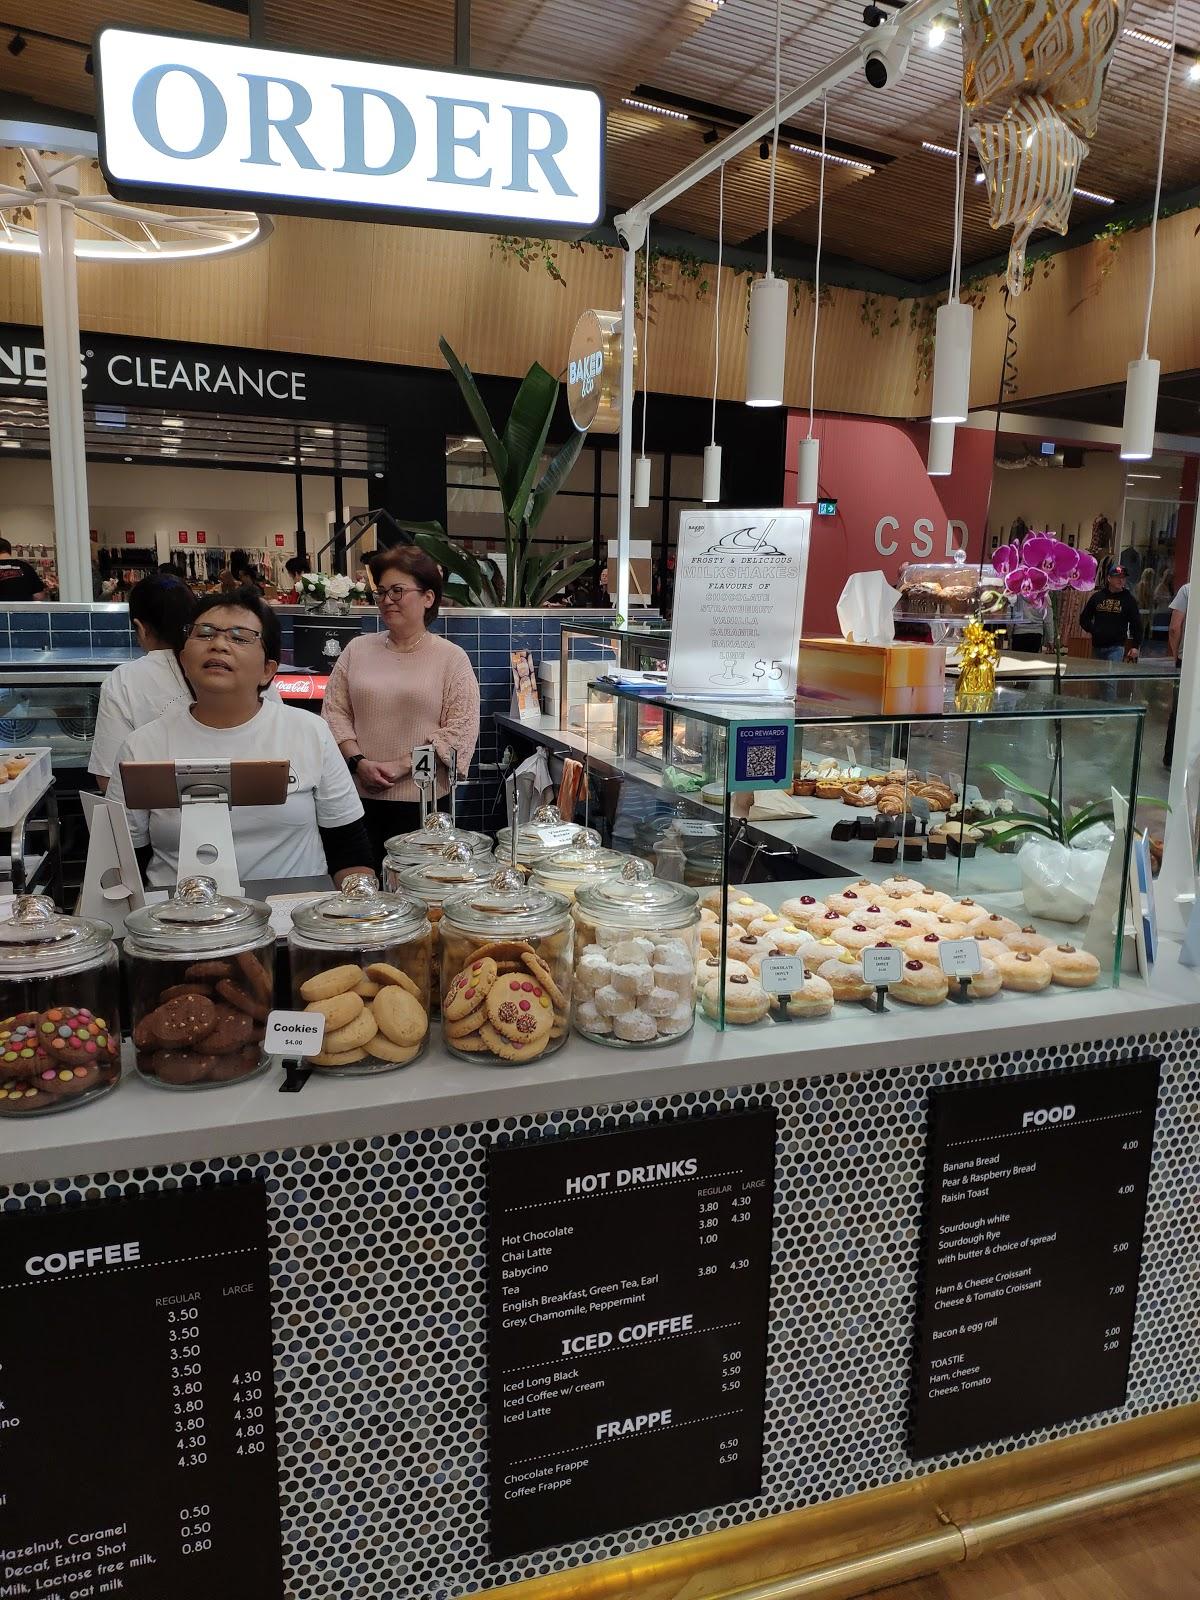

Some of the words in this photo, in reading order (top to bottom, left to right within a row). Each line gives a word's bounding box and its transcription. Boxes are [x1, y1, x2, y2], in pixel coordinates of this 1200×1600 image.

[131, 62, 579, 198] ORDER
[107, 354, 307, 401] CLEARANCE
[569, 351, 603, 385] BAKED
[682, 565, 799, 579] MILKSHAKES
[705, 593, 770, 602] CHOCOLATE
[700, 605, 774, 614] STRAWBERRY
[712, 616, 759, 625] VANILLA
[709, 629, 760, 637] CARAMEL
[711, 640, 756, 649] BANANA
[719, 651, 747, 660] LIME
[752, 658, 784, 682] $5
[740, 730, 754, 738] ECO
[754, 729, 785, 737] REWARDS
[415, 754, 431, 777] 4
[273, 1023, 318, 1033] Cookies
[1022, 1104, 1076, 1128] FOOD
[1122, 1139, 1139, 1151] 4.00
[943, 1160, 975, 1173] Banana
[975, 1153, 1000, 1167] Bread
[566, 1171, 611, 1196] HOT
[616, 1158, 698, 1187] DRINKS
[942, 1178, 961, 1188] Pear
[961, 1175, 969, 1185] &
[969, 1169, 1012, 1183] Raspberry
[1012, 1162, 1037, 1176] Bread
[697, 1184, 733, 1197] REGULAR
[741, 1178, 766, 1191] LARGE
[941, 1191, 966, 1204] Raisin
[966, 1187, 989, 1199] Toast
[1118, 1184, 1135, 1195] 4.00
[699, 1201, 719, 1214] 3.80
[731, 1195, 752, 1207] 4.30
[698, 1217, 719, 1230] 3.80
[730, 1211, 751, 1223] 4.30
[939, 1217, 986, 1235] Sourdough
[986, 1214, 1011, 1225] white
[501, 1234, 521, 1246] Hot
[522, 1226, 574, 1242] Chocolate
[699, 1233, 718, 1245] 1.00
[938, 1232, 985, 1250] Sourdough
[985, 1231, 1001, 1242] Rye
[501, 1250, 525, 1263] Chai
[526, 1247, 553, 1259] Latte
[937, 1253, 956, 1265] with
[957, 1249, 984, 1261] butter
[984, 1246, 992, 1256] &
[992, 1242, 1019, 1254] choice
[1019, 1237, 1030, 1248] of
[1029, 1231, 1057, 1247] spread
[1112, 1241, 1129, 1254] 5.00
[25, 1241, 141, 1276] COFFEE
[697, 1265, 718, 1277] 3.80
[729, 1258, 750, 1270] 4.30
[502, 1264, 549, 1280] Babycino
[935, 1285, 955, 1296] Ham
[956, 1281, 964, 1291] &
[964, 1276, 994, 1289] Cheese
[995, 1267, 1032, 1282] Croissant
[155, 1291, 201, 1307] REGULAR
[222, 1282, 254, 1296] LARGE
[501, 1286, 520, 1296] Tea
[502, 1297, 539, 1313] English
[541, 1288, 588, 1305] Breakfast,
[589, 1283, 619, 1296] Green
[620, 1279, 640, 1290] Tea,
[640, 1273, 659, 1286] Earl
[934, 1297, 965, 1310] Cheese
[965, 1294, 973, 1304] &
[973, 1288, 1005, 1302] Tomato
[1005, 1279, 1042, 1294] Croissant
[1109, 1284, 1125, 1296] 7.00
[167, 1307, 199, 1323] 3.50
[502, 1317, 528, 1329] Grey,
[528, 1304, 588, 1324] Chamomile,
[589, 1293, 646, 1312] Peppermint
[168, 1326, 200, 1342] 3.50
[561, 1331, 613, 1356] ICED
[618, 1313, 694, 1344] COFFEE
[932, 1328, 958, 1340] Bacon
[959, 1324, 966, 1334] &
[966, 1322, 984, 1333] egg
[984, 1316, 998, 1328] roll
[1104, 1326, 1121, 1338] 5.00
[170, 1344, 201, 1360] 3.50
[1103, 1339, 1120, 1352] 5.00
[722, 1350, 742, 1363] 5.00
[930, 1353, 965, 1369] TOASTIE
[171, 1362, 202, 1379] 3.50
[722, 1365, 741, 1378] 5.50
[929, 1373, 951, 1384] Ham,
[951, 1366, 981, 1379] cheese
[172, 1381, 203, 1397] 3.80
[232, 1370, 262, 1385] 4.30
[503, 1379, 525, 1393] Iced
[526, 1376, 552, 1388] Long
[553, 1368, 579, 1382] Black
[721, 1380, 741, 1392] 5.50
[928, 1385, 960, 1399] Cheese,
[960, 1377, 992, 1390] Tomato
[173, 1399, 204, 1415] 3.80
[232, 1388, 262, 1403] 4.30
[503, 1395, 525, 1408] Iced
[526, 1390, 559, 1403] Coffee
[560, 1384, 574, 1396] w/
[574, 1380, 605, 1393] cream
[174, 1417, 205, 1433] 3.80
[233, 1406, 263, 1421] 4.30
[503, 1410, 525, 1424] Iced
[526, 1407, 552, 1419] Latte
[596, 1408, 672, 1441] FRAPPE
[176, 1434, 206, 1450] 4.30
[235, 1423, 264, 1439] 4.80
[719, 1438, 739, 1450] 6.50
[177, 1452, 207, 1468] 4.30
[236, 1441, 265, 1456] 4.80
[719, 1452, 738, 1464] 6.50
[504, 1467, 554, 1485] Chocolate
[555, 1459, 589, 1473] Frappe
[504, 1486, 537, 1500] Coffee
[538, 1478, 572, 1492] Frappe
[179, 1504, 210, 1521] 0.50
[67, 1522, 127, 1545] Caramel
[180, 1521, 211, 1538] 0.50
[181, 1538, 212, 1555] 0.80
[4, 1558, 51, 1579] Decaf,
[55, 1551, 92, 1568] Extra
[96, 1541, 127, 1558] Shot
[0, 1583, 32, 1598] Milk,
[35, 1569, 93, 1590] Lactose
[97, 1561, 125, 1576] free
[129, 1553, 157, 1568] milk,
[69, 1584, 95, 1600] oat
[99, 1578, 124, 1593] milk
